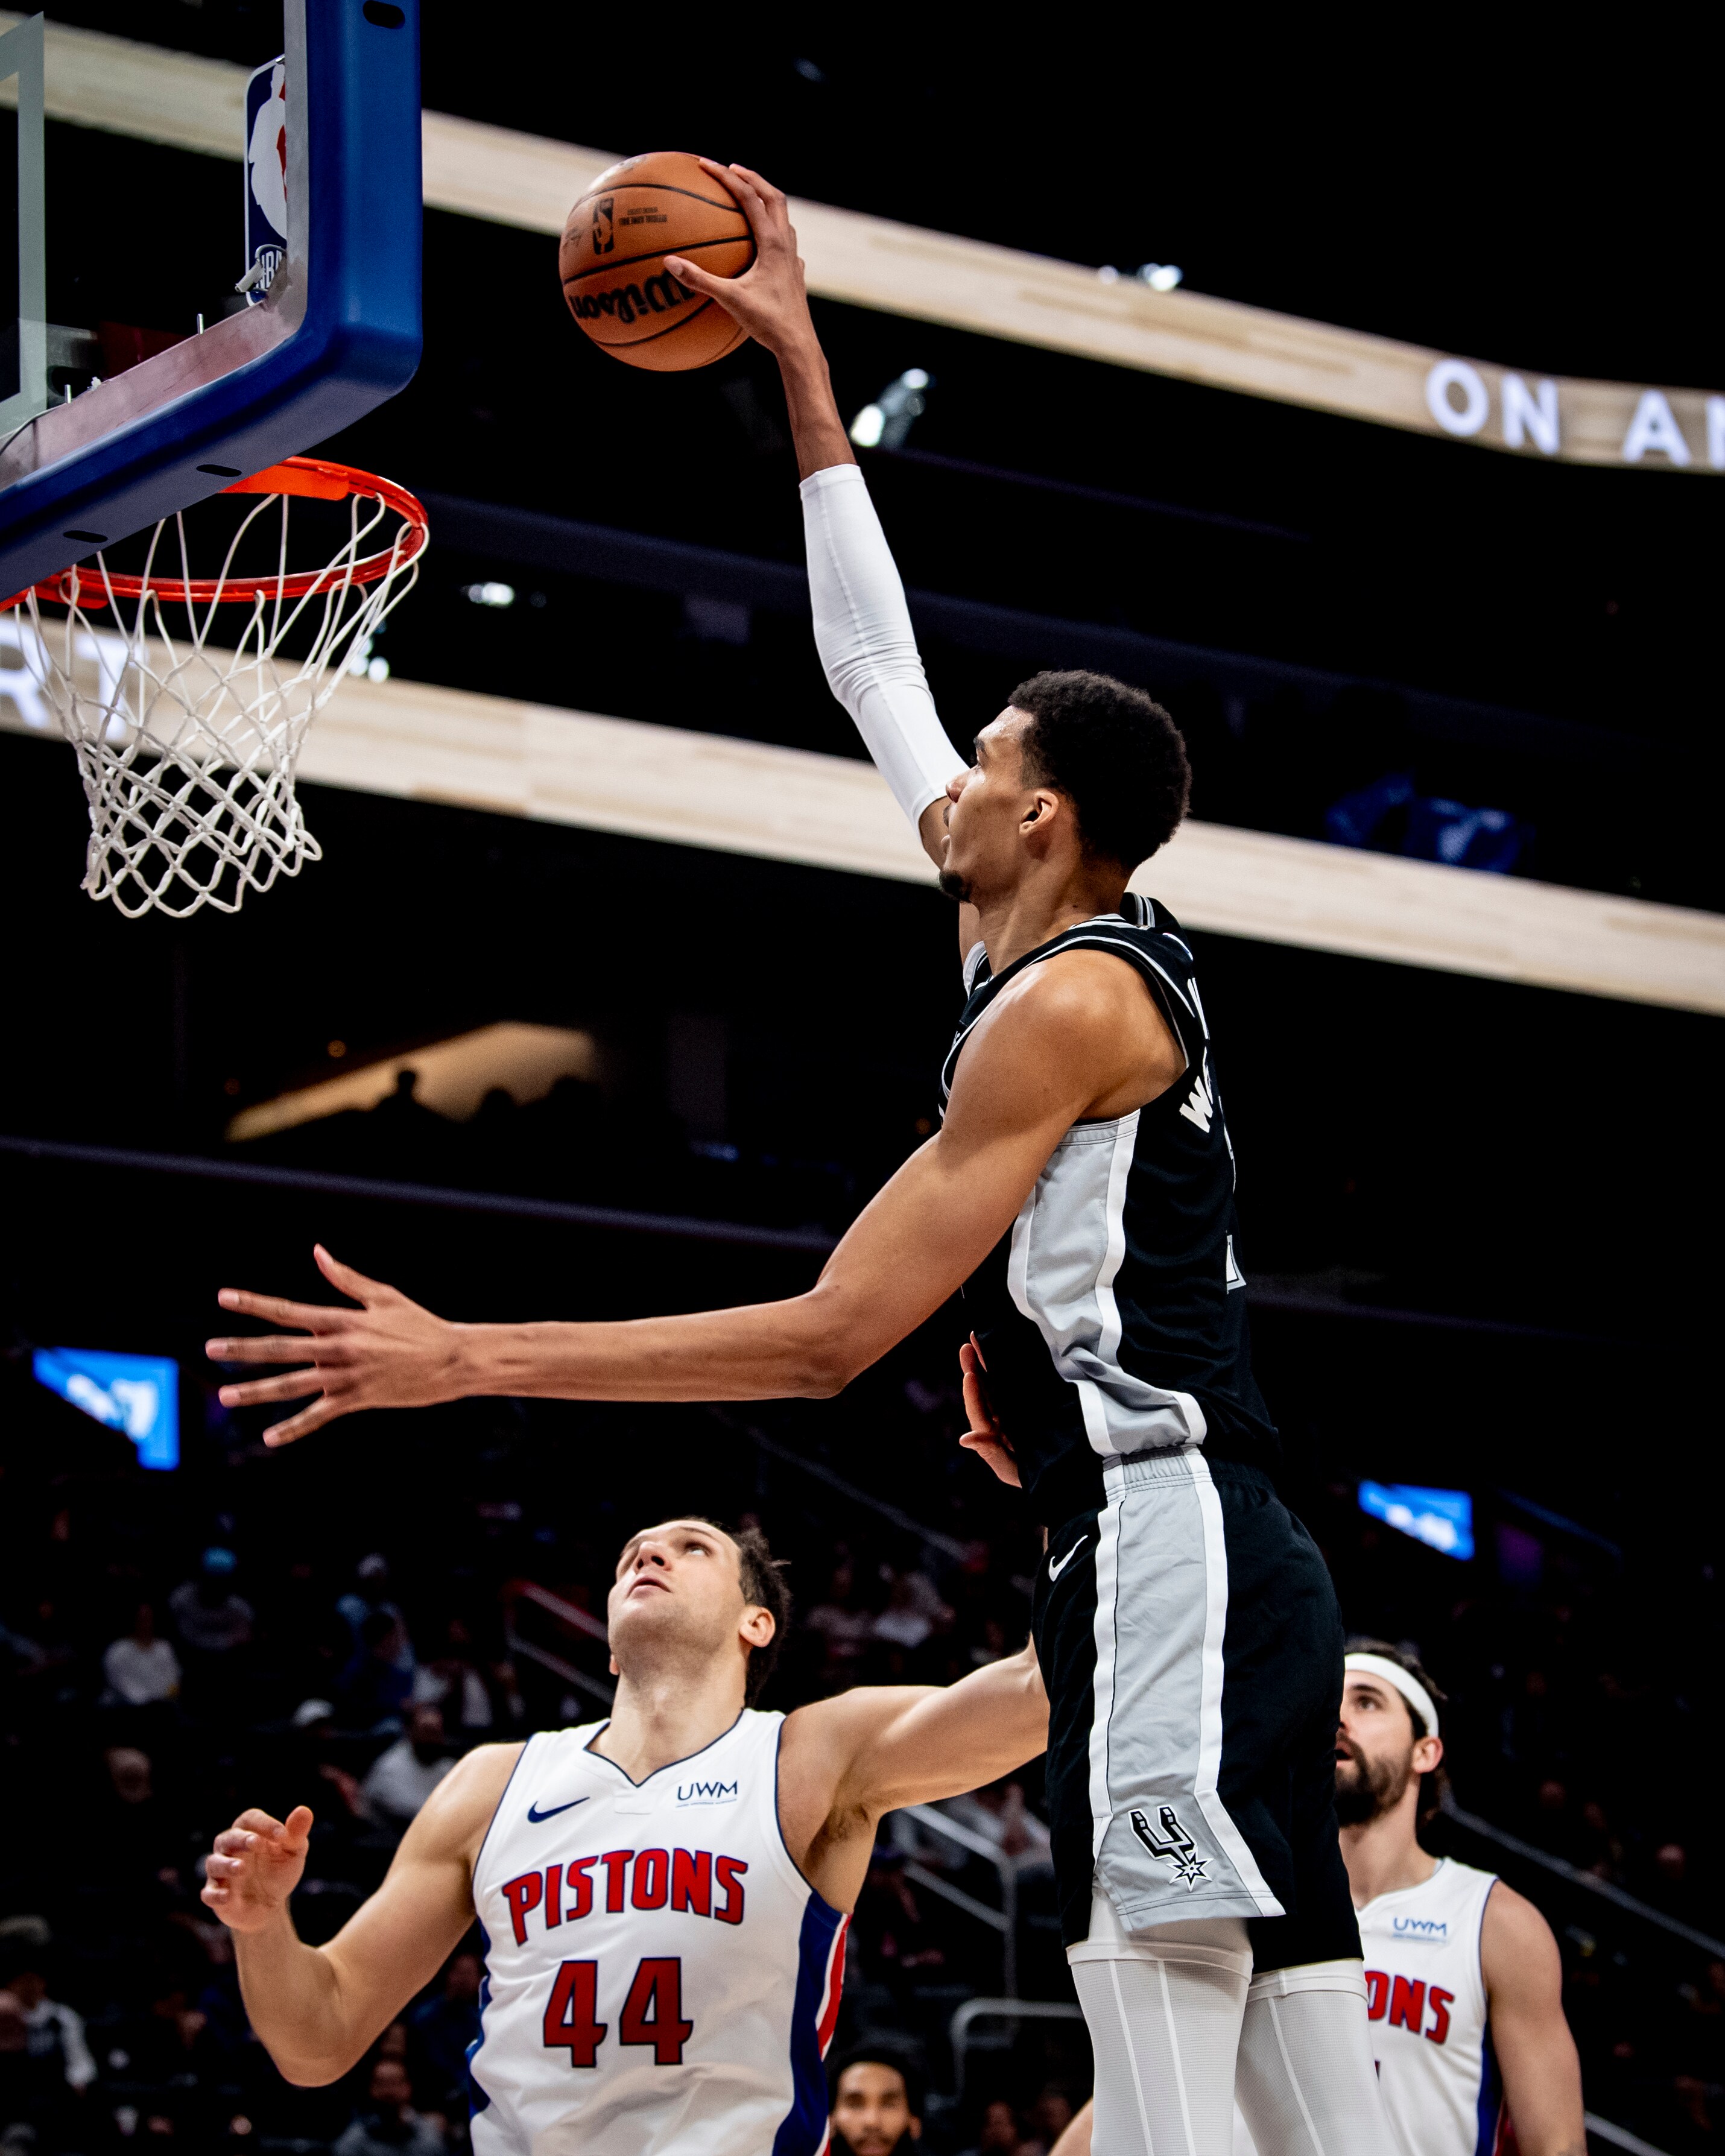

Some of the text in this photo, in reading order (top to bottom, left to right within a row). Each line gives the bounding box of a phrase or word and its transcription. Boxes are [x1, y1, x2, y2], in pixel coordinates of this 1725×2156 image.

[569, 269, 695, 323] Wilson
[1426, 358, 1560, 457] ON
[677, 1780, 737, 1800] UWM
[502, 1848, 748, 1947] PISTONS
[1393, 1917, 1446, 1936] UWM
[543, 1957, 694, 2067] 44
